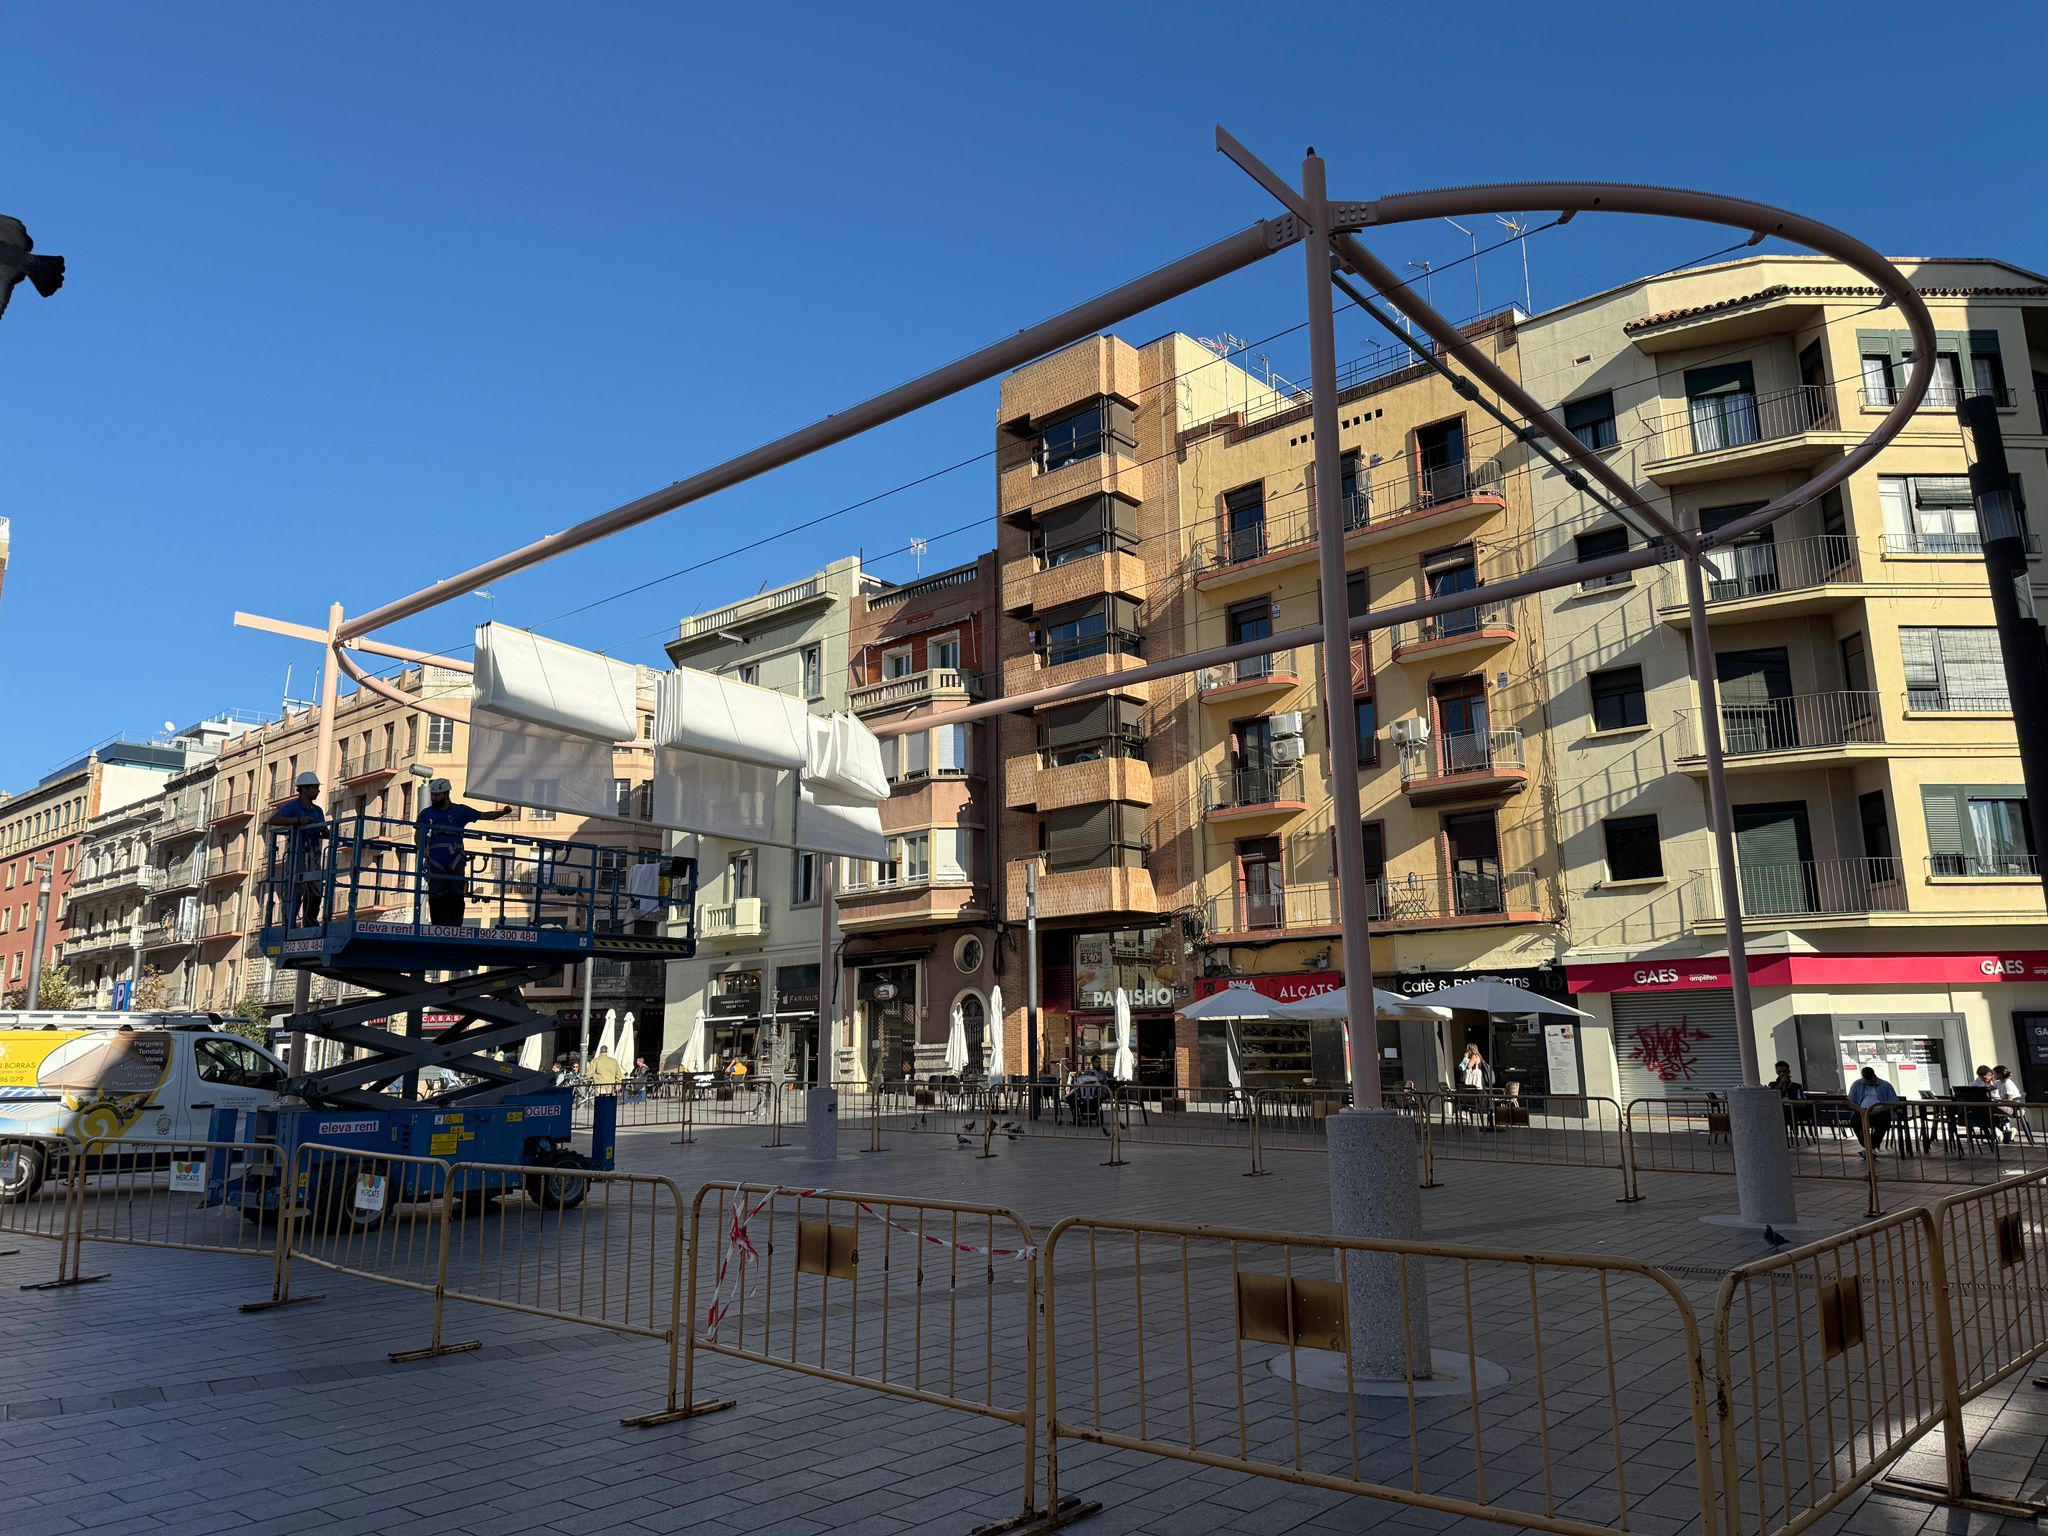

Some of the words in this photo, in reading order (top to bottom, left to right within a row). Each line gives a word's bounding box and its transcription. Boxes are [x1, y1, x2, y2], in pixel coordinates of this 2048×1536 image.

[358, 922, 388, 933] eleva
[390, 925, 414, 935] rent
[421, 927, 474, 938] LLOGUER
[479, 930, 497, 939] 902
[500, 931, 517, 940] 300
[519, 932, 537, 942] 484
[283, 942, 295, 952] 902
[297, 941, 309, 952] 300
[310, 940, 323, 950] 484
[1980, 959, 2025, 975] GAES
[1633, 968, 1679, 984] GAES
[1688, 974, 1718, 983] amplifon
[1402, 979, 1436, 993] Cafè
[1439, 979, 1451, 990] &
[789, 994, 819, 1002] FARINUS
[1093, 987, 1174, 1007] PAISHO
[321, 1123, 352, 1133] eleva
[355, 1121, 377, 1132] rent
[175, 1174, 200, 1182] MERCATS
